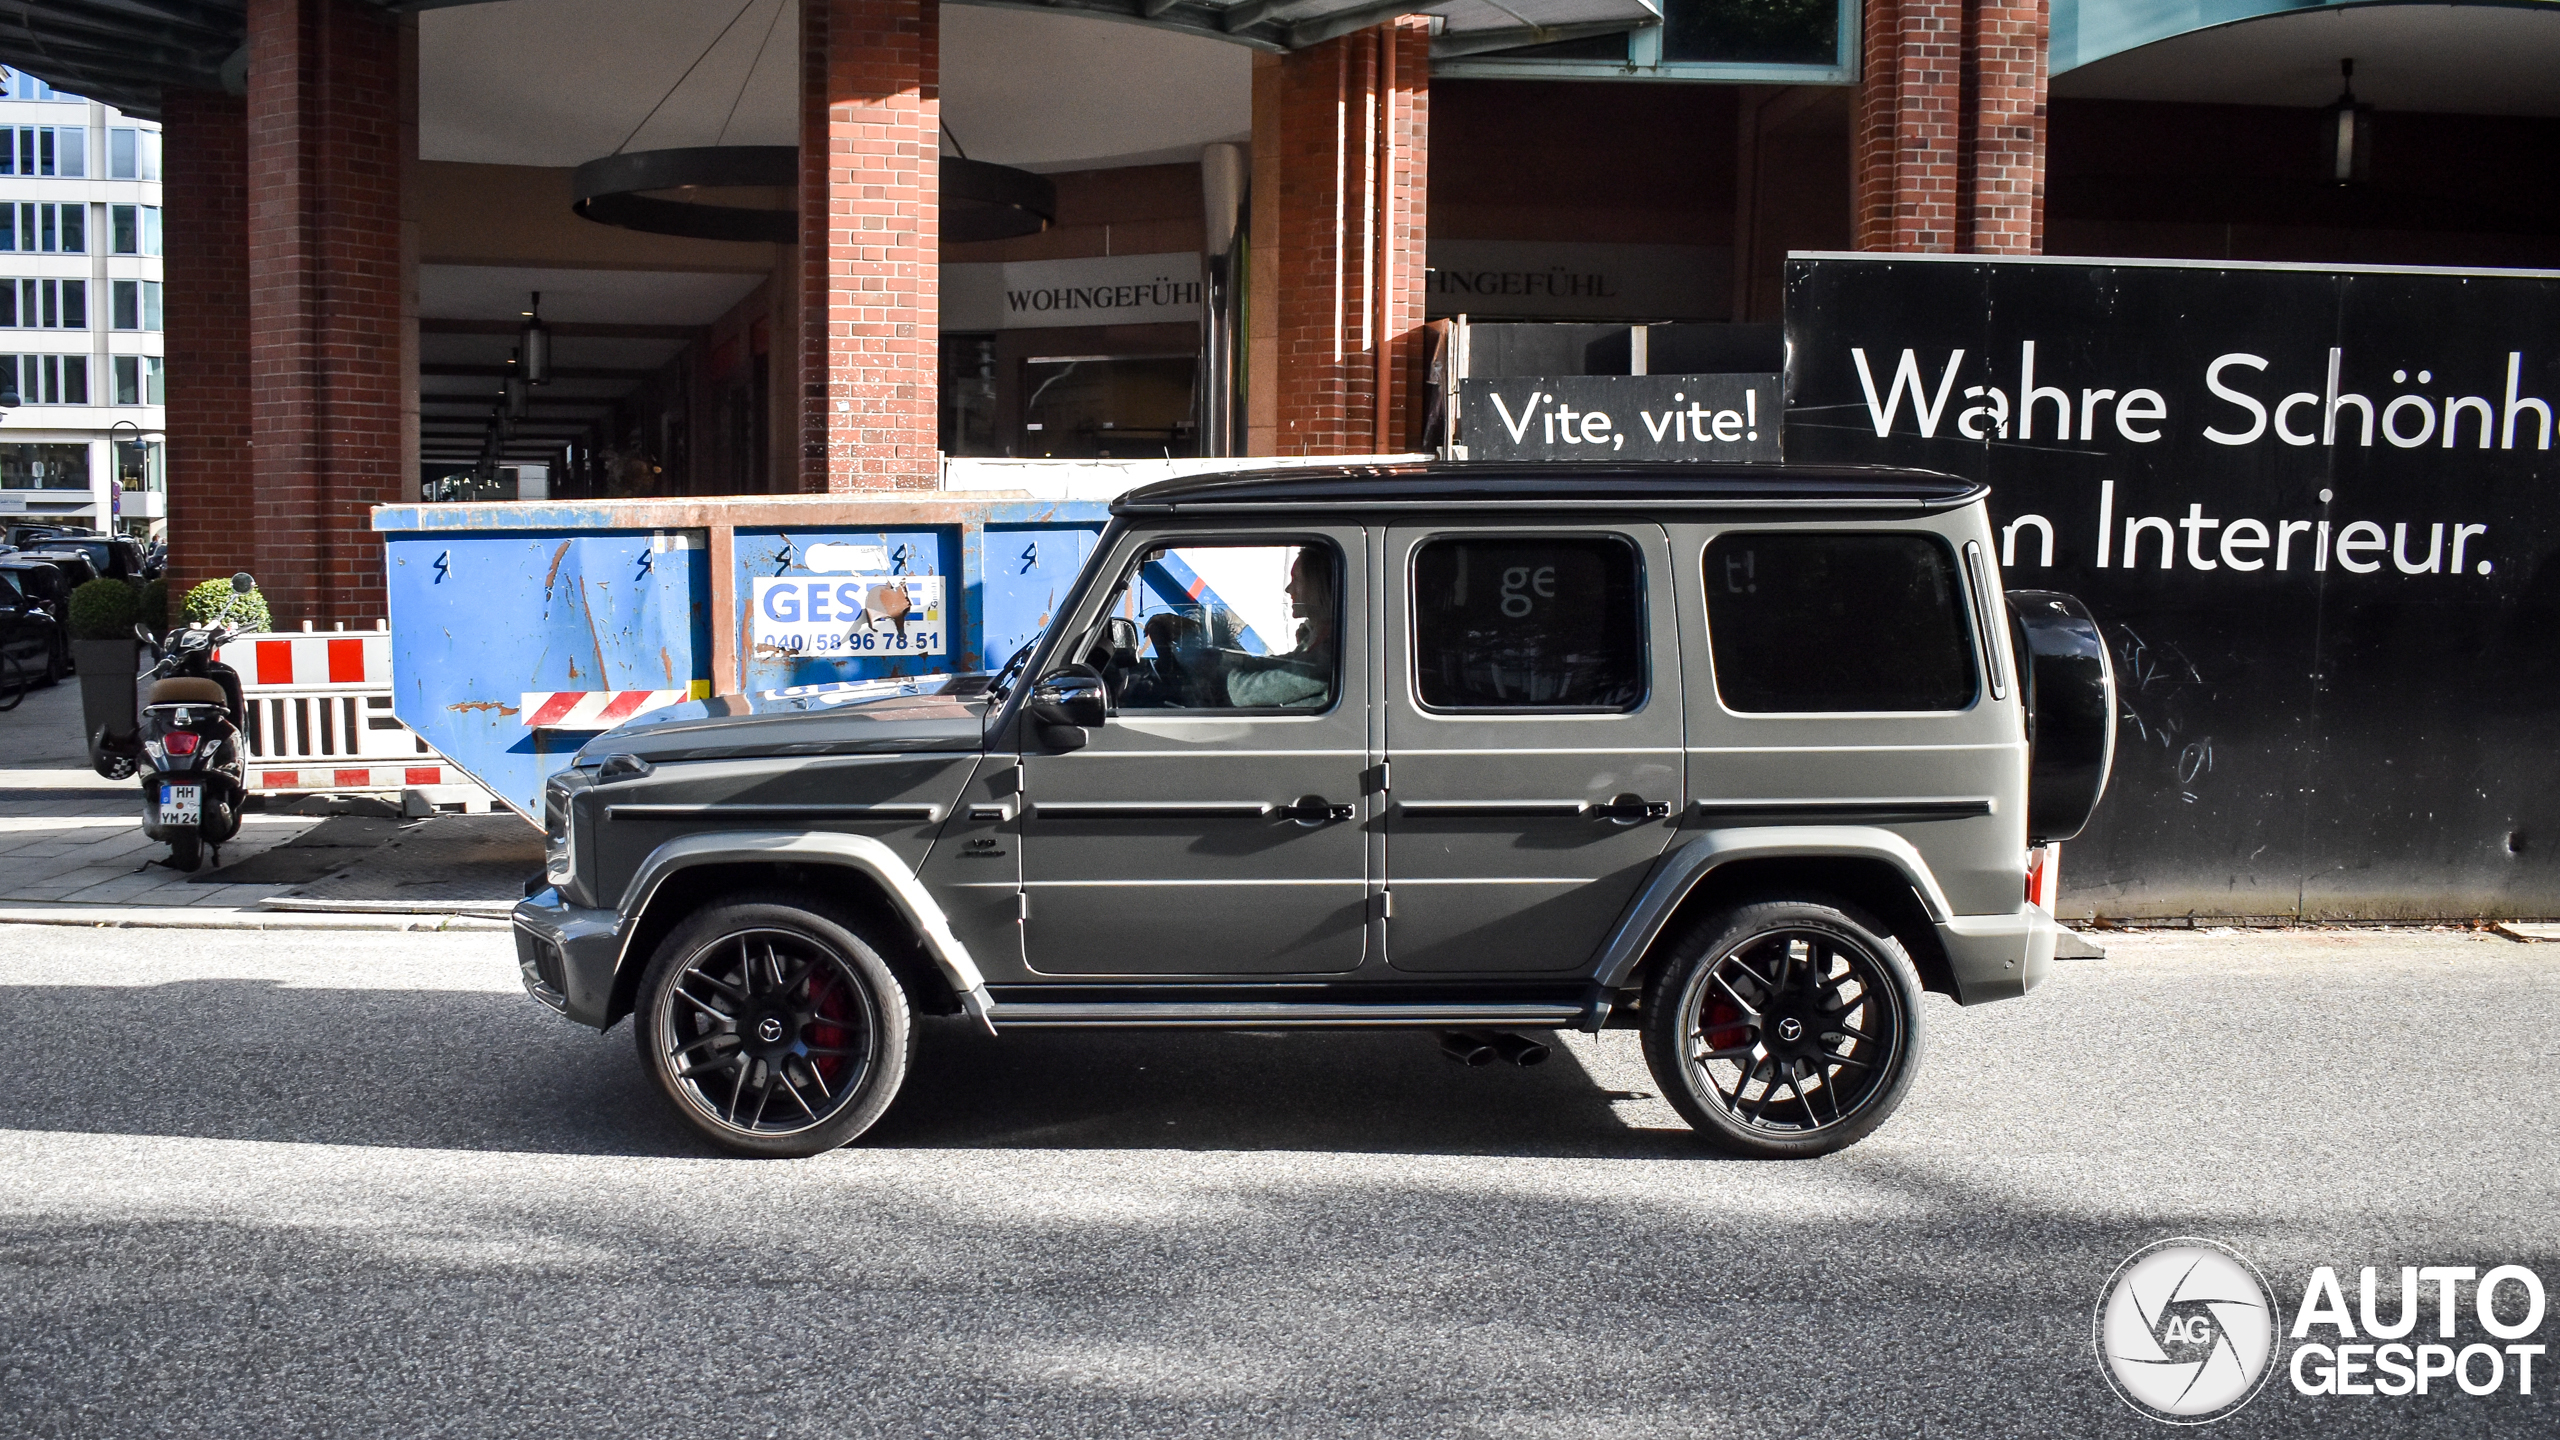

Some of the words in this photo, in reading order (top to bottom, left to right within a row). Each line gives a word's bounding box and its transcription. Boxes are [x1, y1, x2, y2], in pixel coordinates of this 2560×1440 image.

[1425, 266, 1617, 297] HNGEFÜHL
[1851, 340, 2167, 443] Wahre
[2202, 347, 2560, 450] Schönh
[1489, 391, 1624, 451] Vite,
[1640, 388, 1758, 442] vite!
[2096, 480, 2492, 575] Interieur.
[763, 582, 924, 623] GESE
[849, 632, 875, 651] 96
[882, 632, 908, 650] 78
[916, 631, 939, 650] 51
[176, 786, 194, 798] HH
[162, 812, 179, 824] YM
[182, 812, 199, 824] 24
